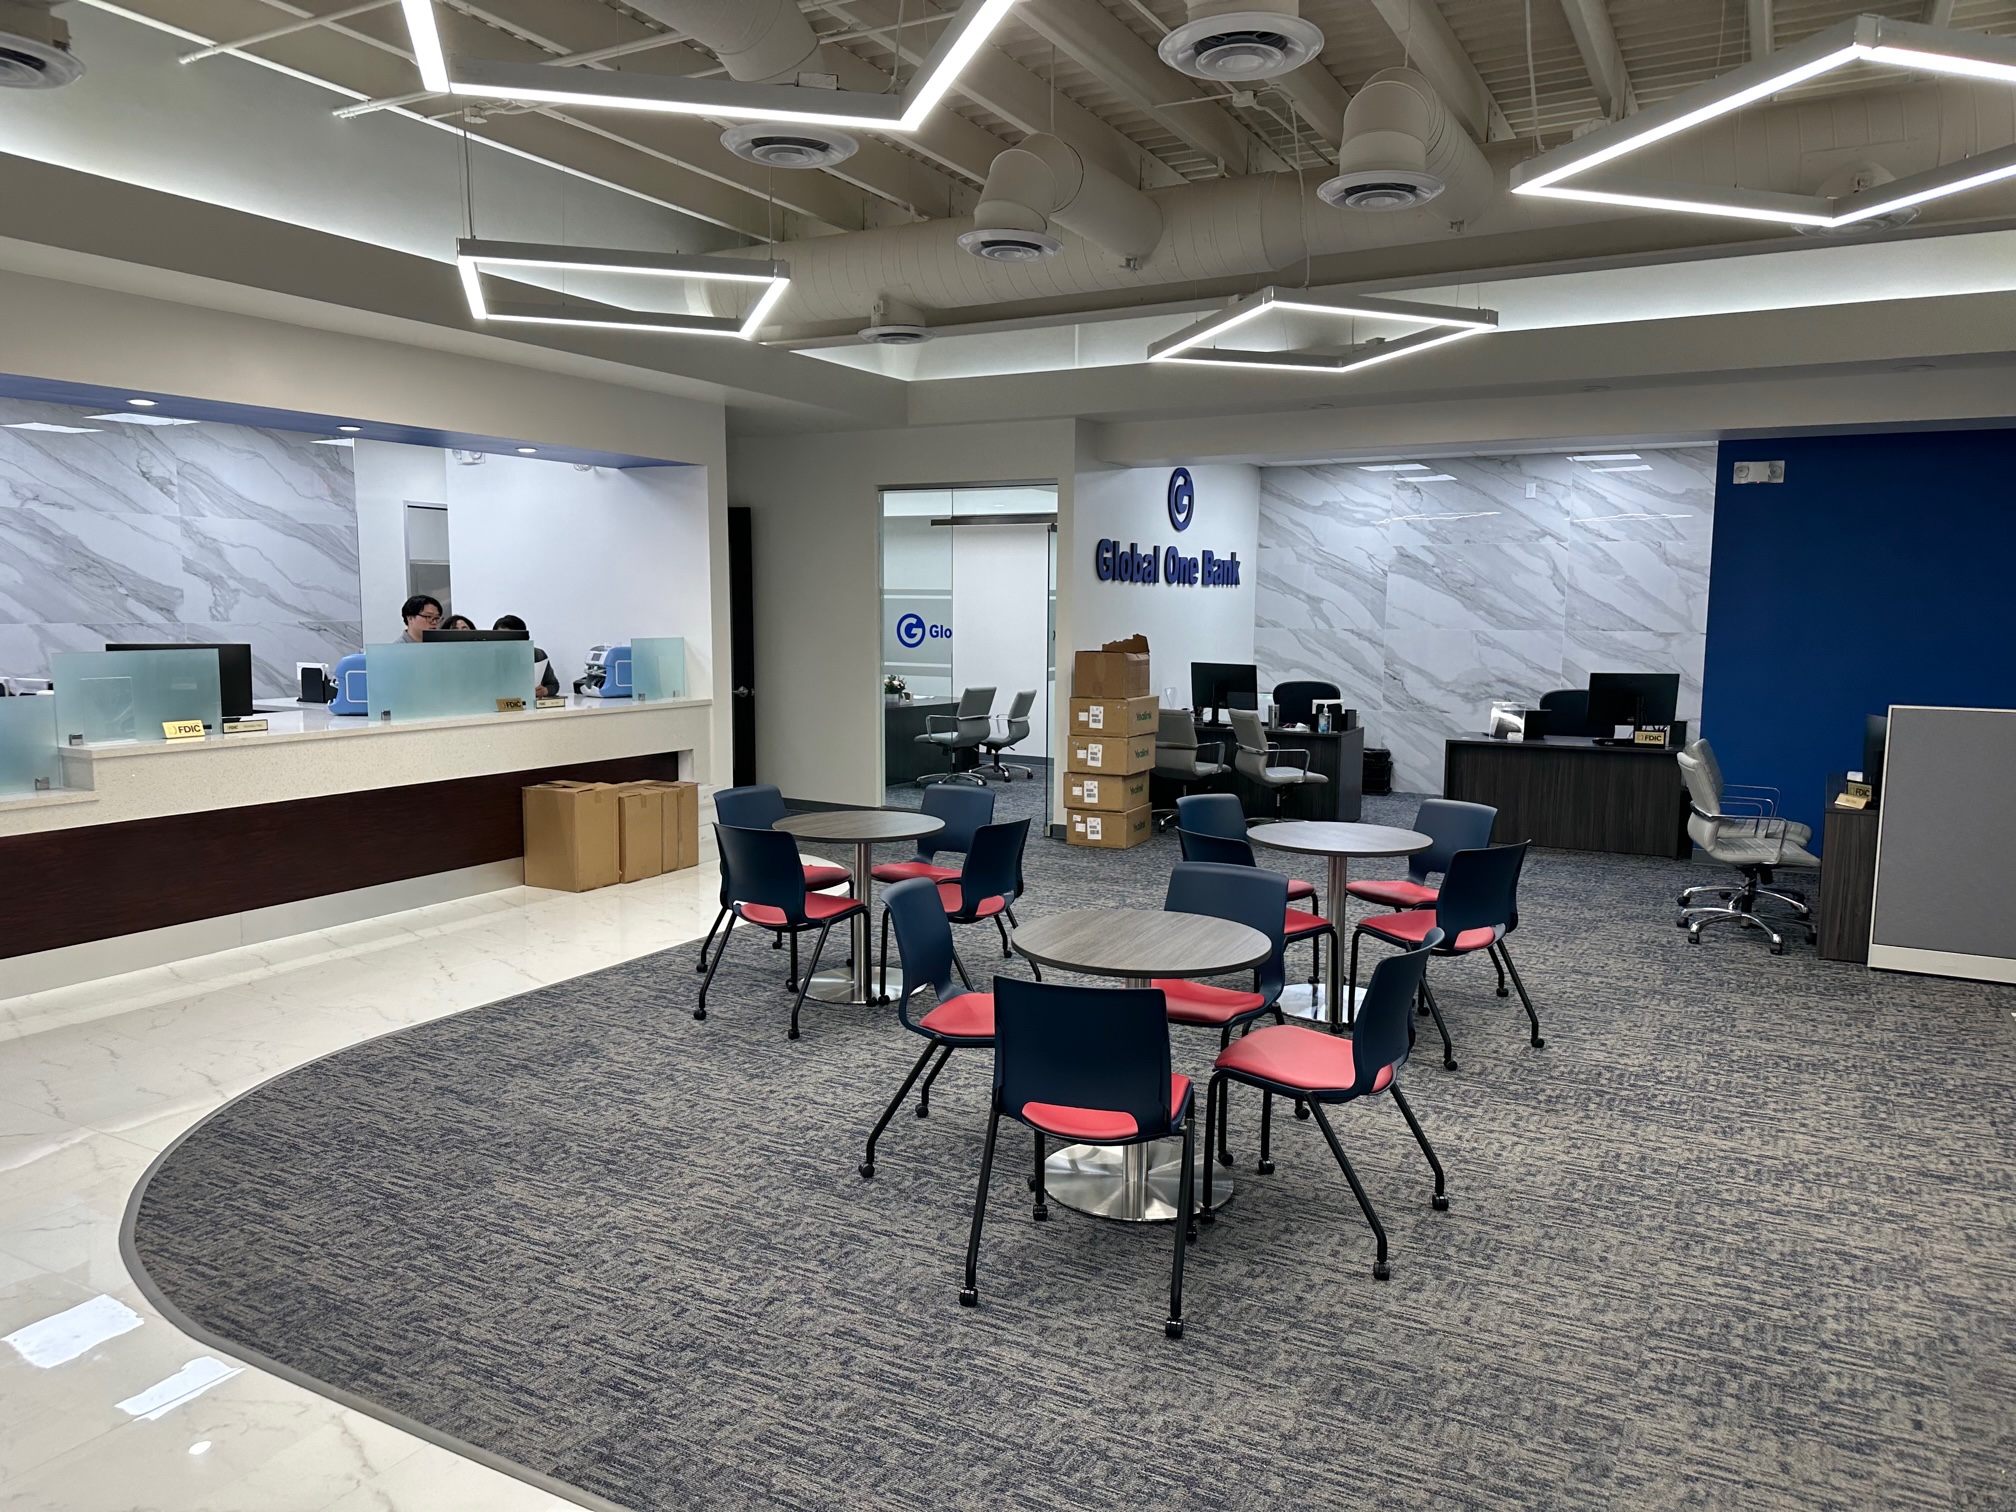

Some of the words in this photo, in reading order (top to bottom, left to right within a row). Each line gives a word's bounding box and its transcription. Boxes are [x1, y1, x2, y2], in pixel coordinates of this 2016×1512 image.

[1096, 538, 1160, 583] Global
[1164, 545, 1199, 585] One
[1201, 550, 1241, 585] Bank
[506, 701, 522, 709] FDIC
[178, 725, 201, 734] FDIC
[1855, 788, 1870, 797] FDIC
